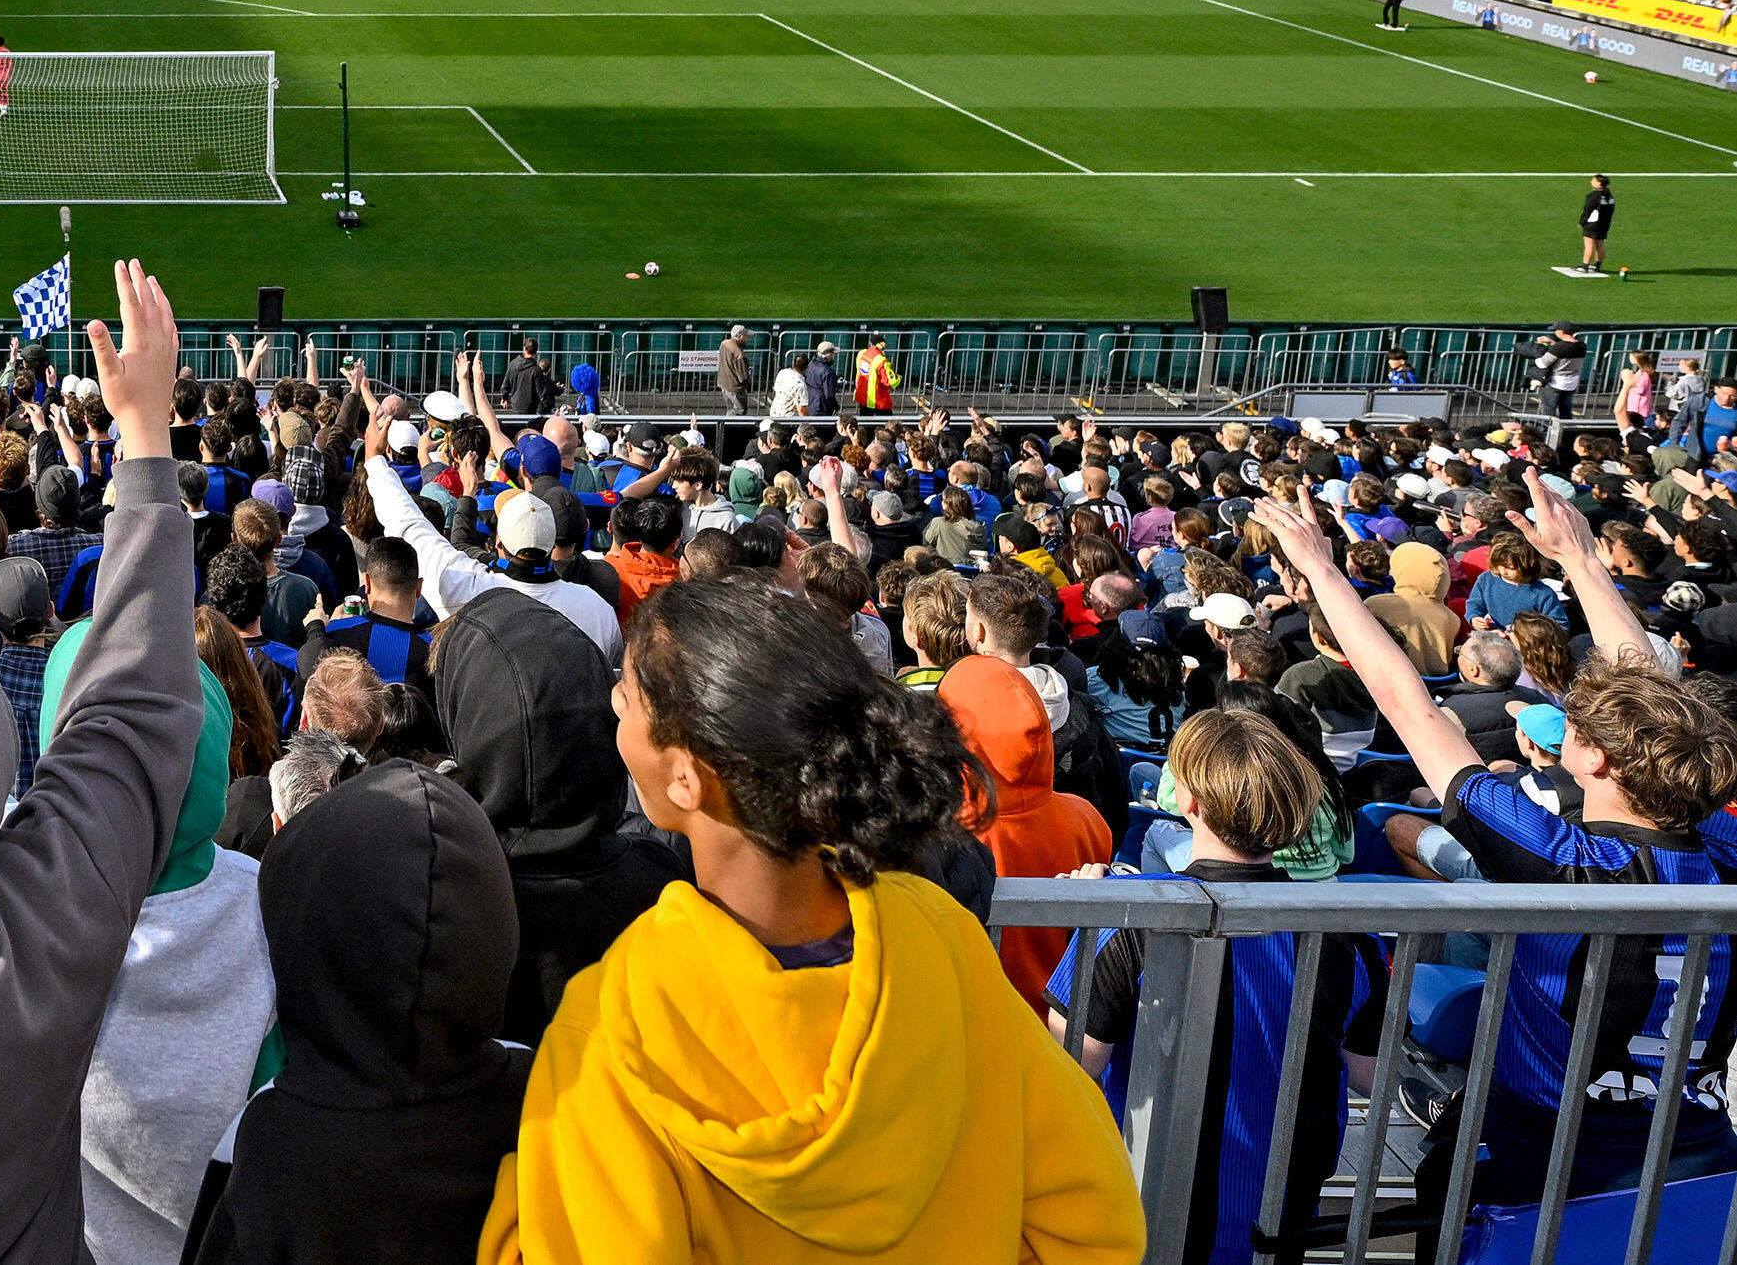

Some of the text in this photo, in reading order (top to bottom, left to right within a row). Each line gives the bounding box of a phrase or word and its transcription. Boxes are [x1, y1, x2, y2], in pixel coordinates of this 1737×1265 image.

[1452, 0, 1533, 29] REAL GOOD
[1653, 7, 1707, 29] DHL
[1542, 23, 1635, 56] REAL GOOD
[1682, 56, 1718, 77] REAL
